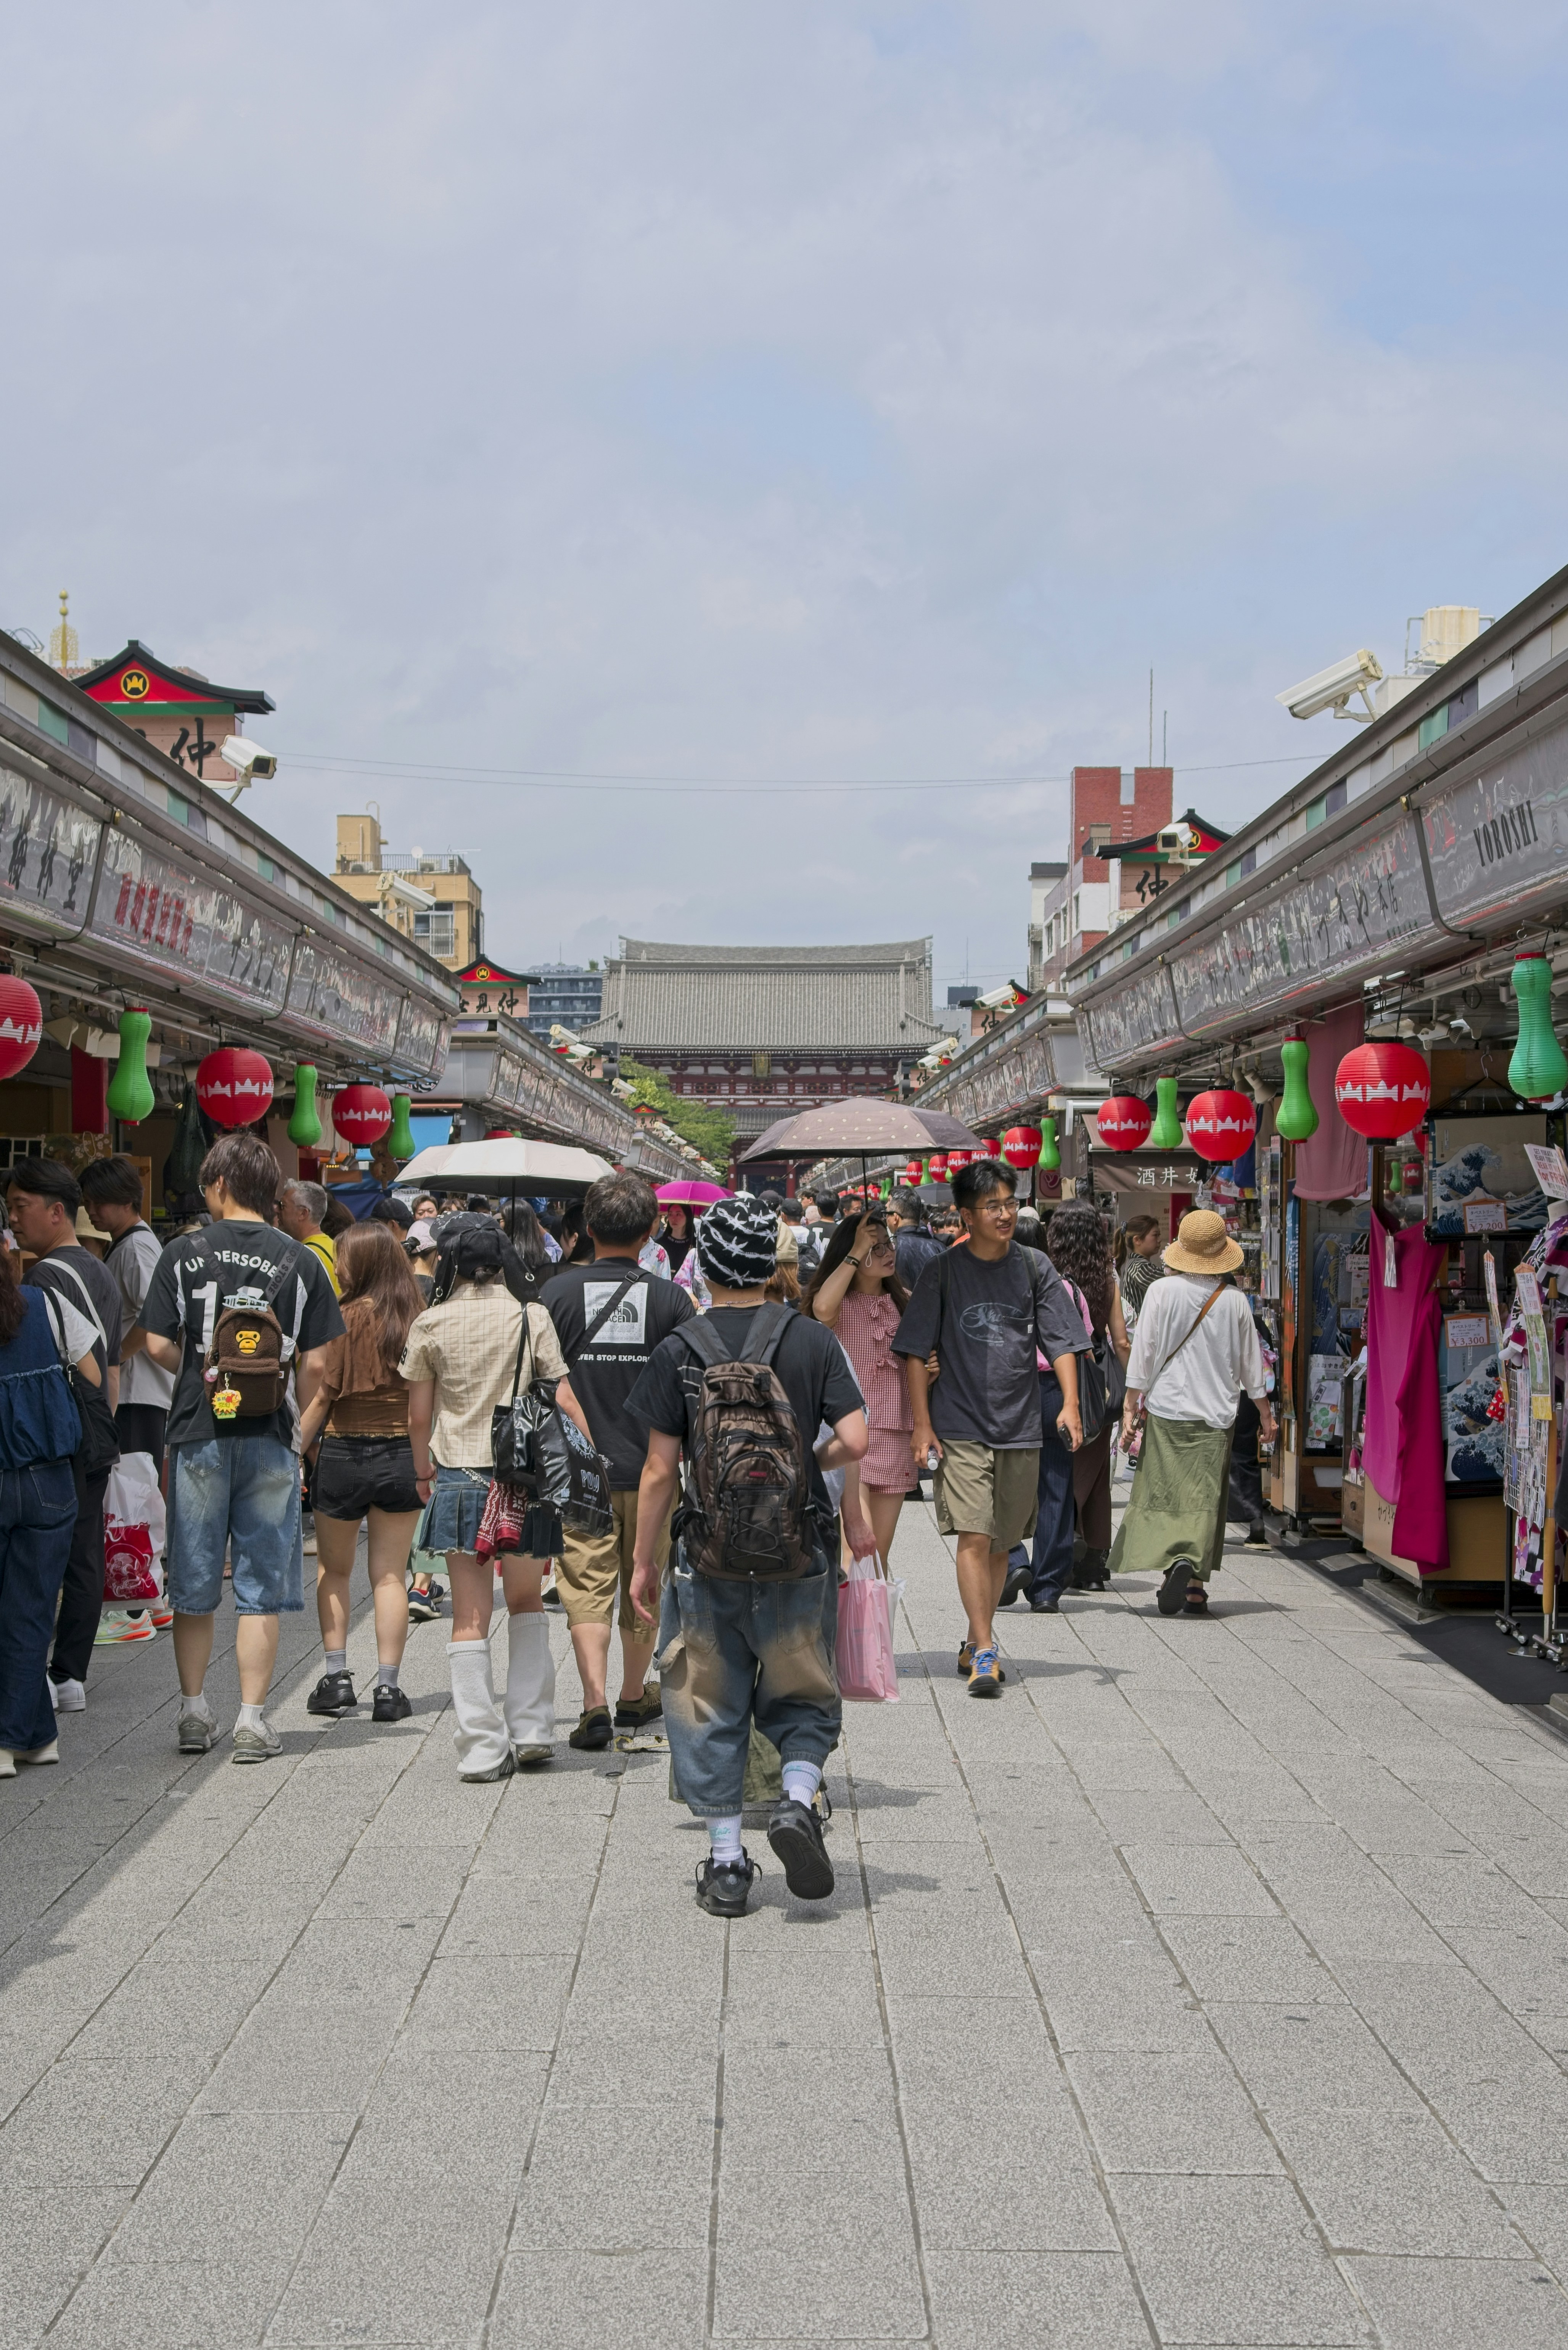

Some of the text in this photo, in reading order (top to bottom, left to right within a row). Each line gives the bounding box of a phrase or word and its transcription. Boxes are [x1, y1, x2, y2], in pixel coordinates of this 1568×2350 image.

[1473, 800, 1539, 867] YOROSHI
[1135, 863, 1169, 903] 仲
[981, 1010, 1000, 1033] 仲
[1537, 1161, 1548, 1169] WEAR
[1537, 1169, 1549, 1181] for
[1470, 1222, 1503, 1231] ¥2,200
[209, 1256, 227, 1282] BABY
[268, 1263, 289, 1295] STORE
[1451, 1337, 1484, 1346] ¥3,300
